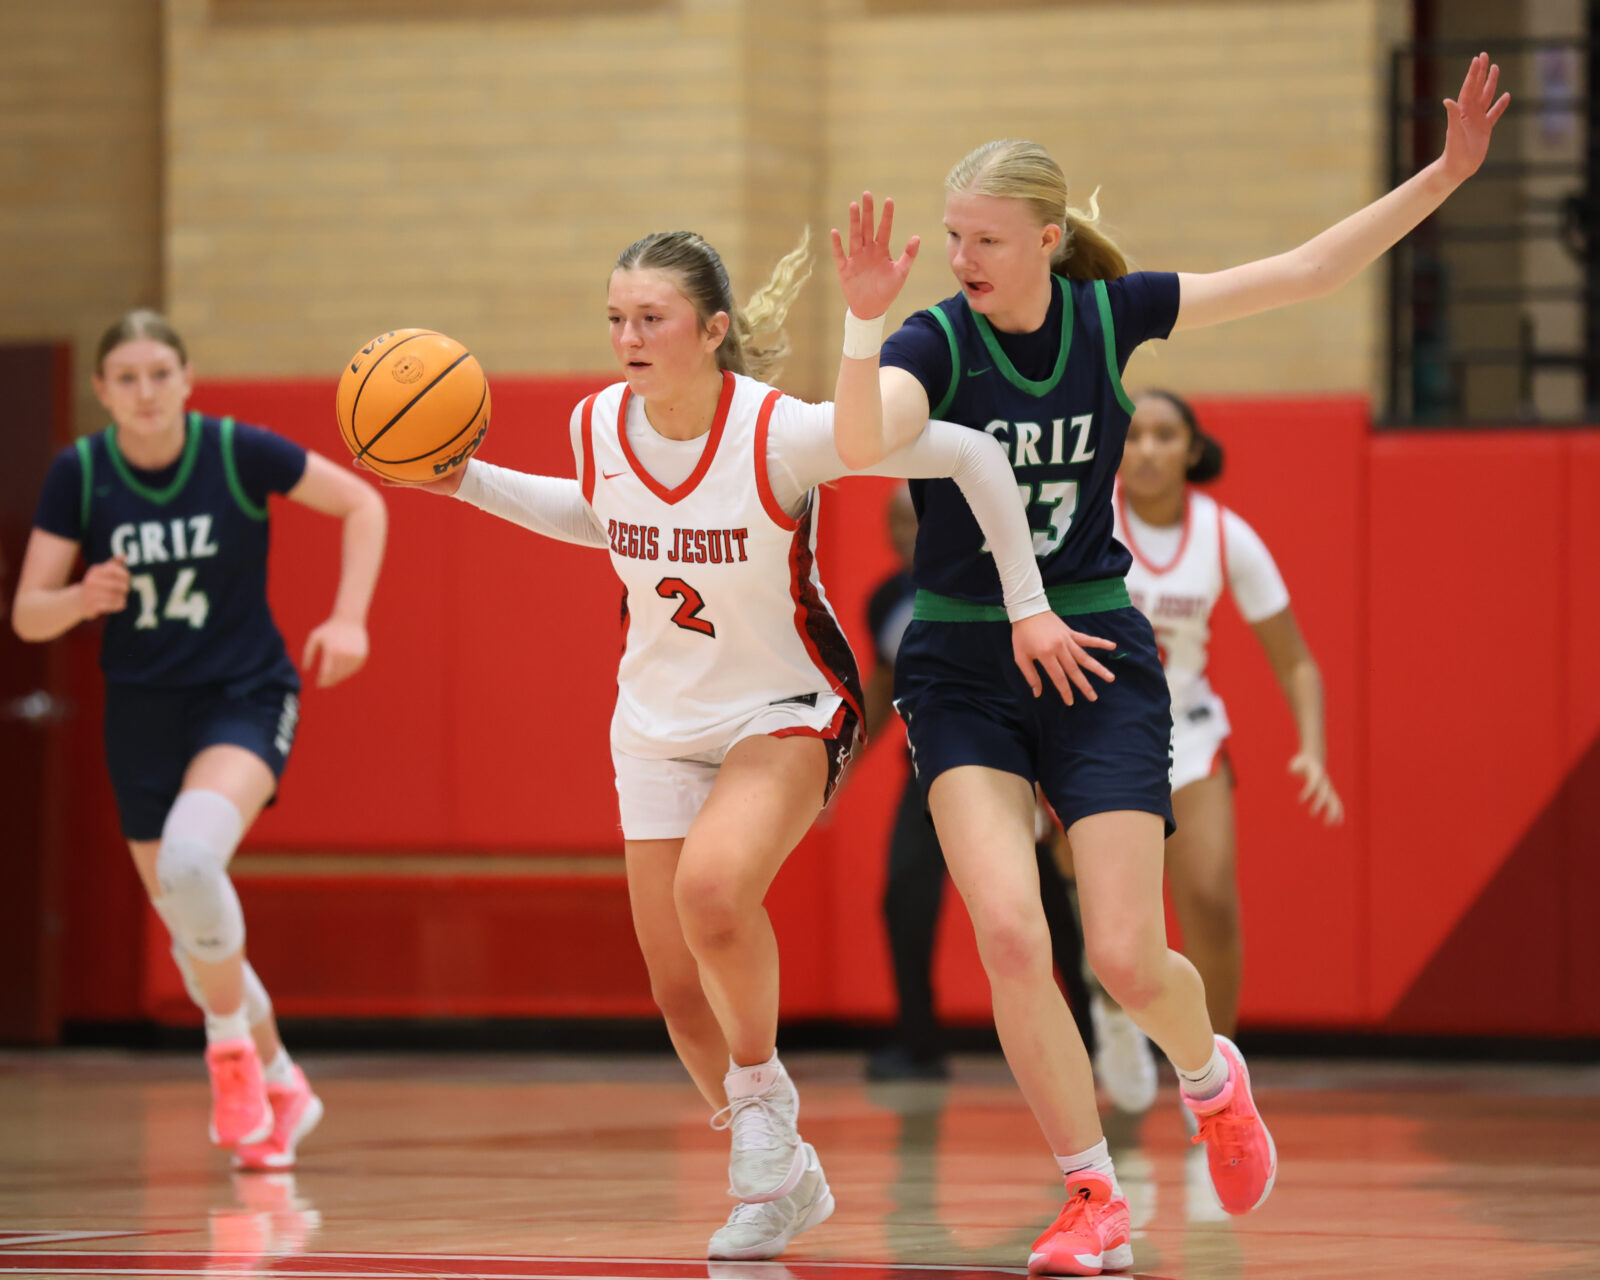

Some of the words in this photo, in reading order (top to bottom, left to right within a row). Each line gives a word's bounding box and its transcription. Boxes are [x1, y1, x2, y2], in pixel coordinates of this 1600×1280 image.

[110, 513, 219, 567] GRIZ
[608, 518, 659, 561] REGIS
[667, 527, 749, 564] JESUIT
[130, 567, 210, 630] 14
[655, 576, 716, 639] 2
